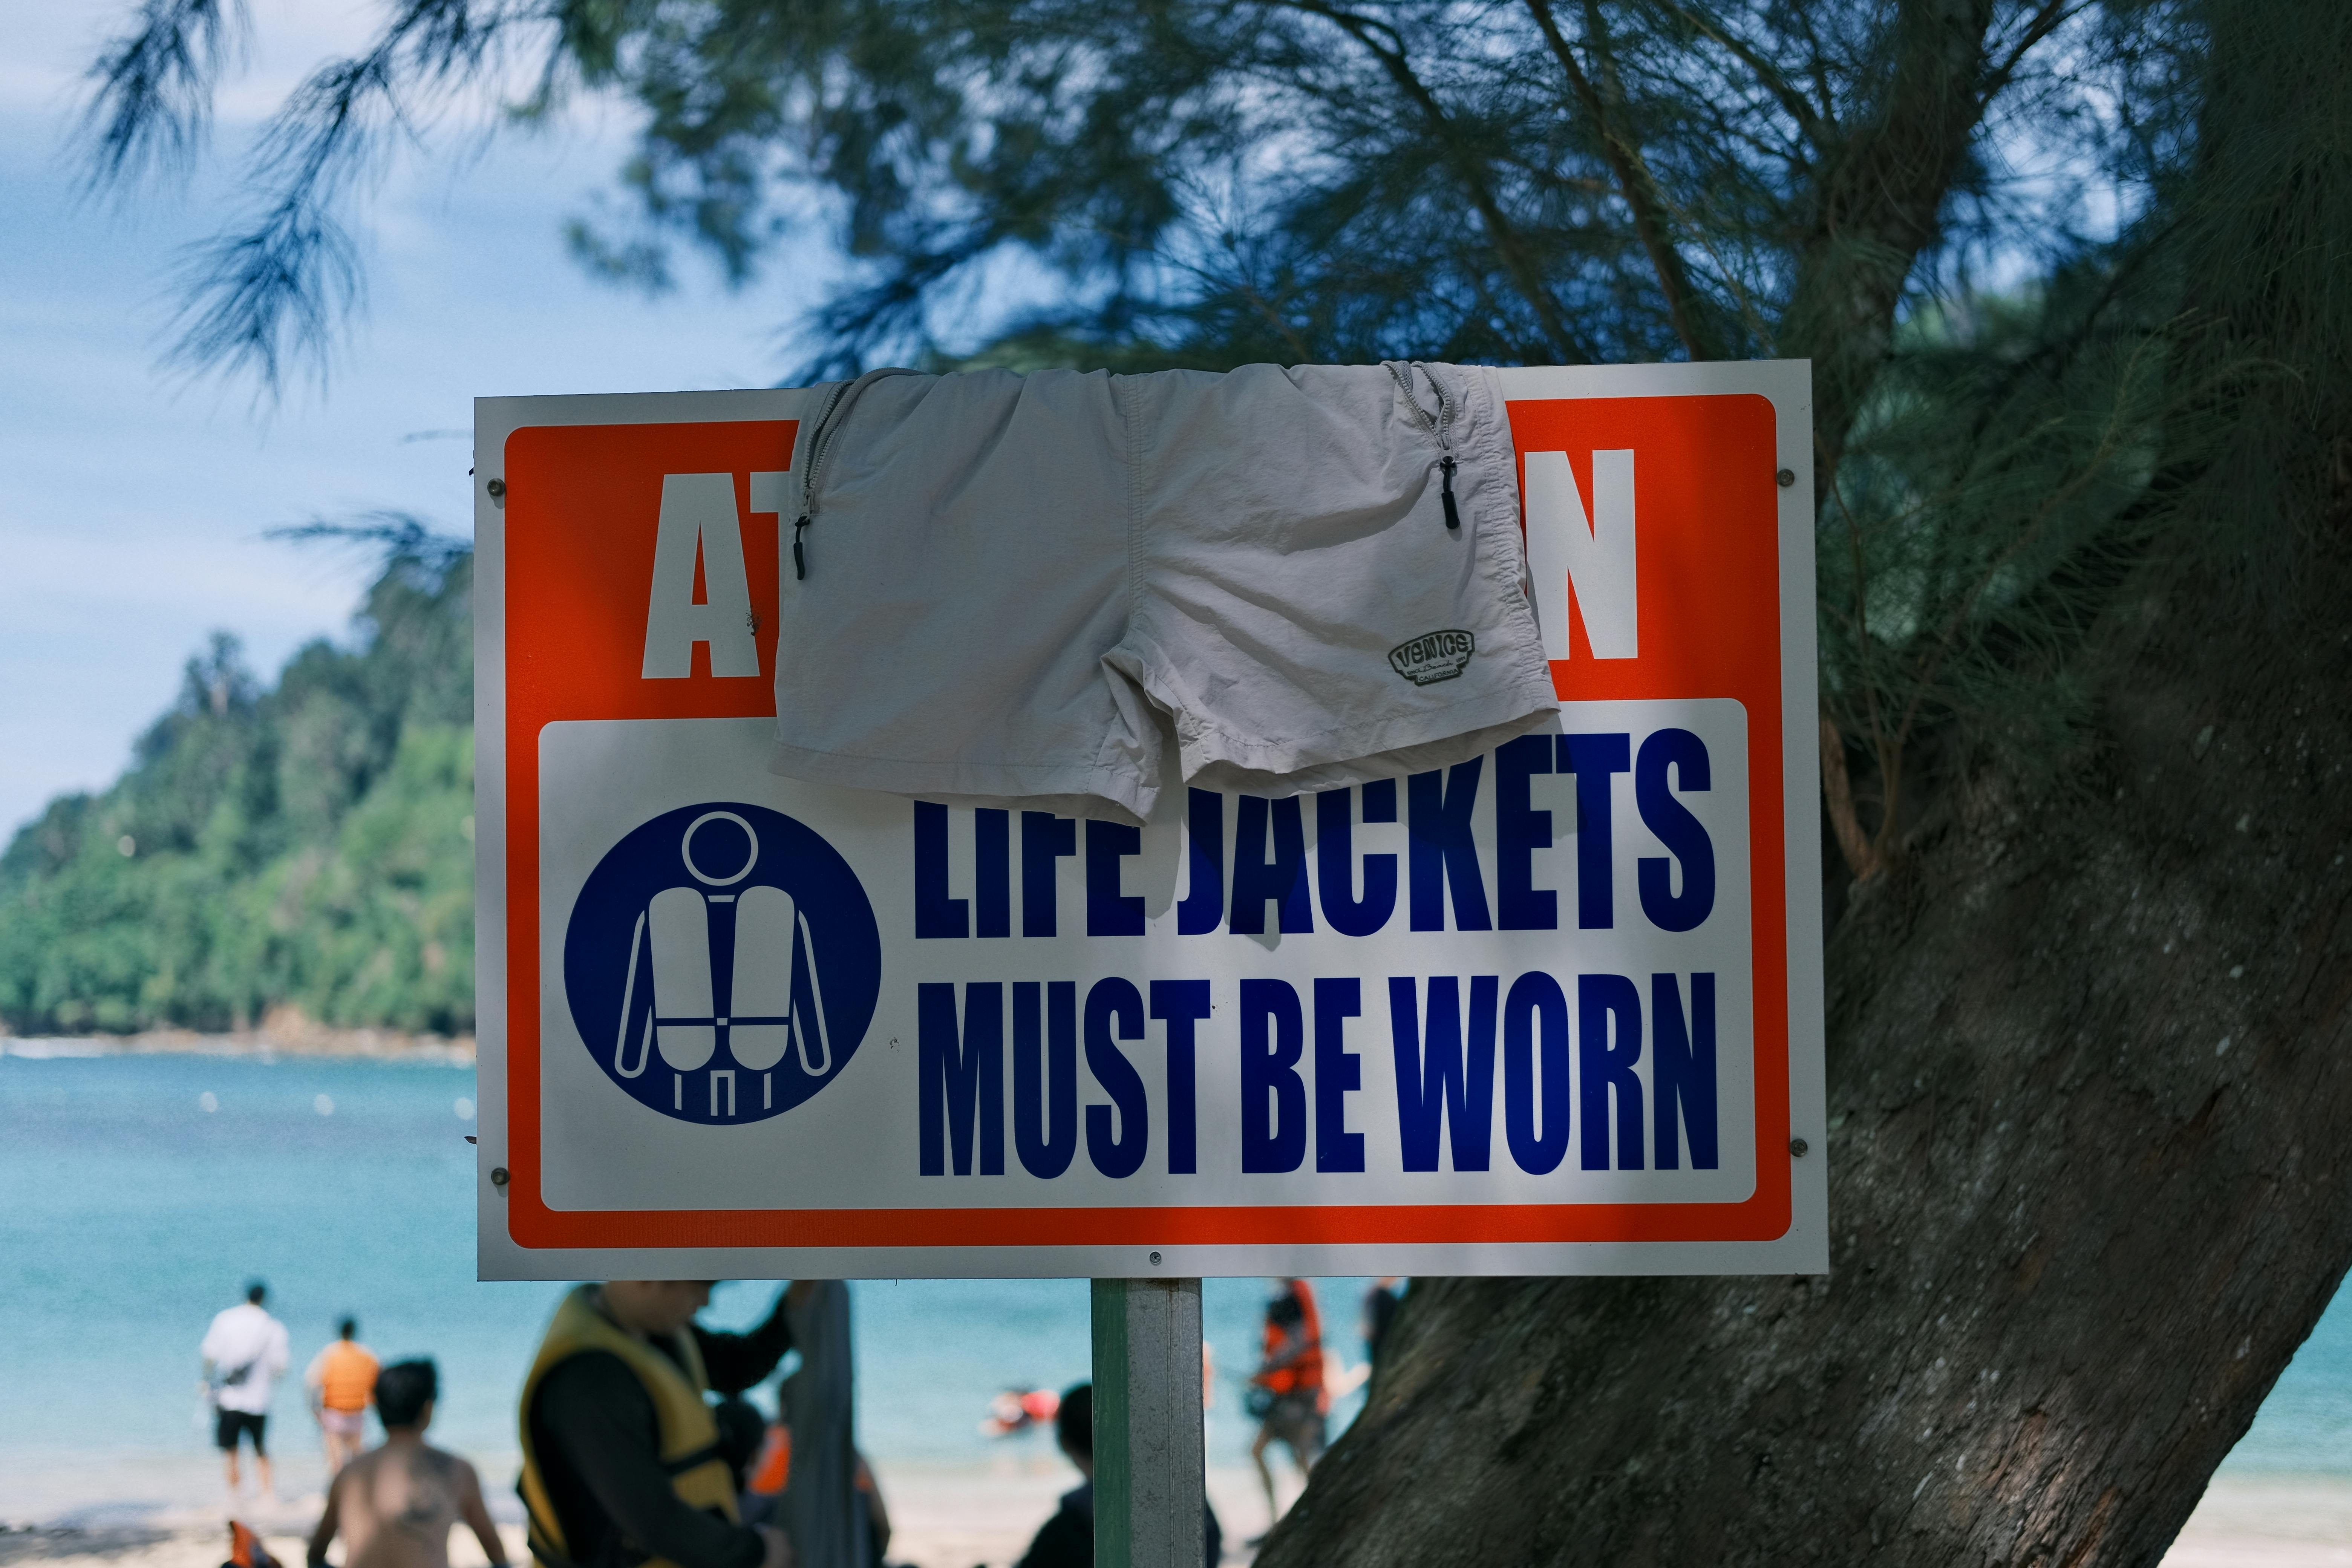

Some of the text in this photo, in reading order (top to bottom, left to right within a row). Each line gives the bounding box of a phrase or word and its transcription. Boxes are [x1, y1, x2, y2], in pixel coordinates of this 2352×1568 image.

[1419, 669, 1458, 681] CALIFORNIA
[914, 728, 1715, 939] LIFE JACKETS
[918, 971, 1718, 1179] MUST BE WORN
